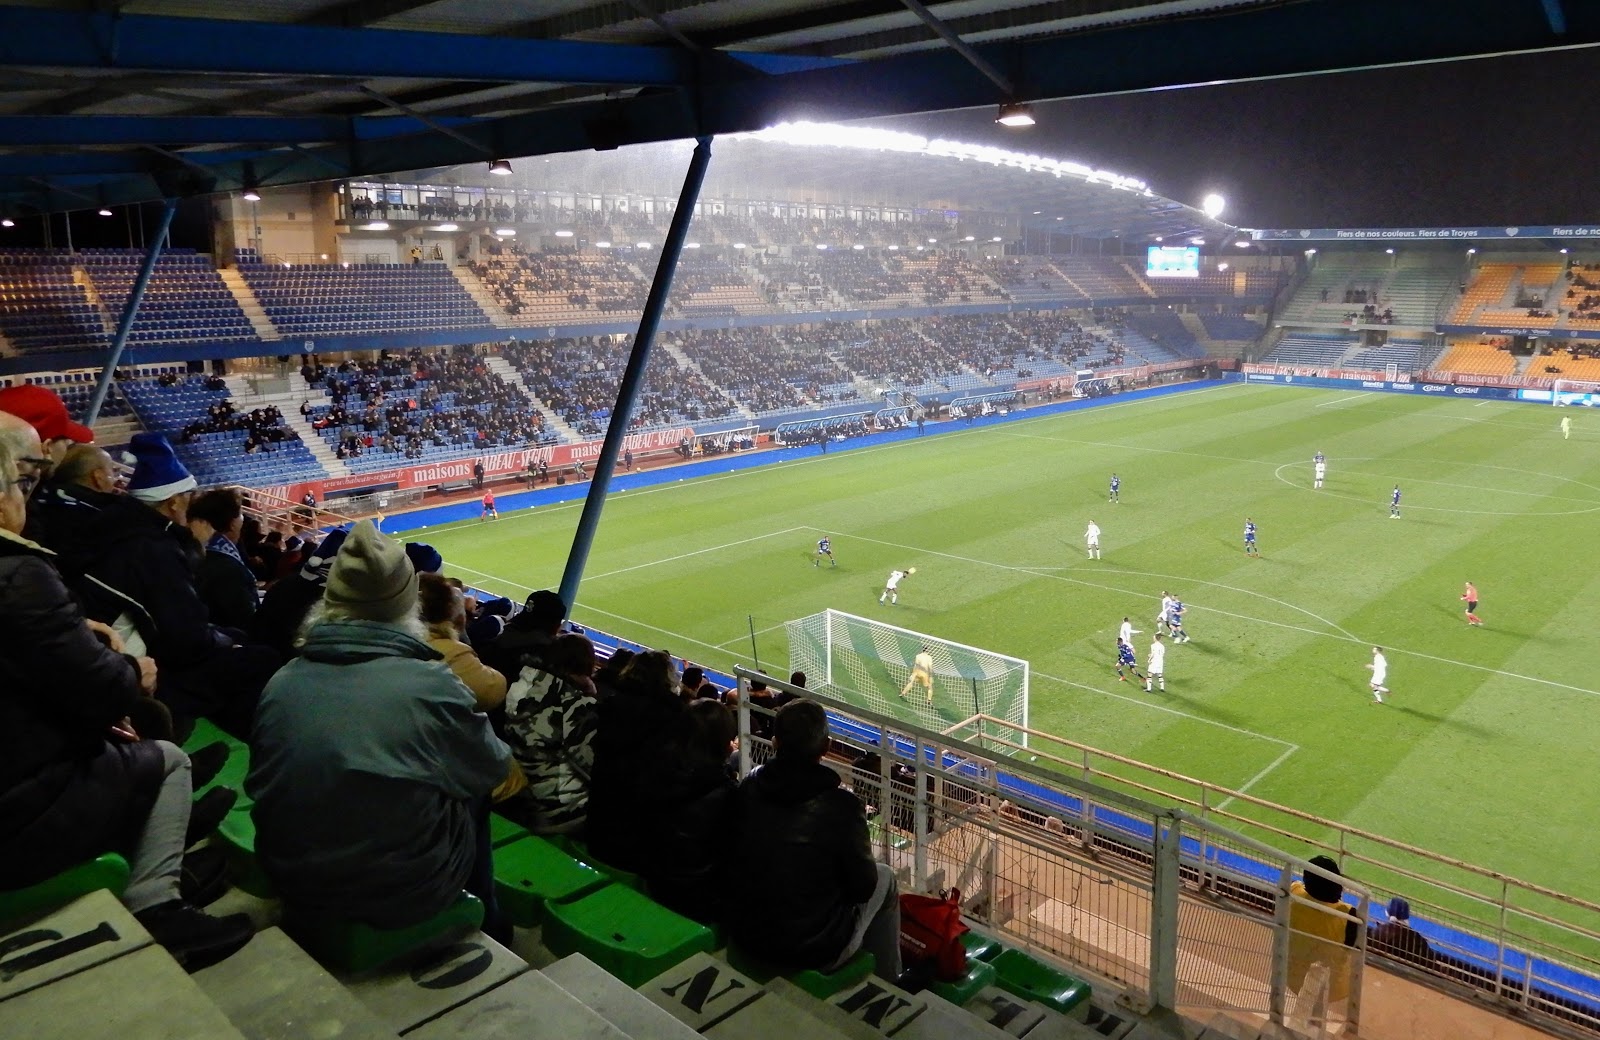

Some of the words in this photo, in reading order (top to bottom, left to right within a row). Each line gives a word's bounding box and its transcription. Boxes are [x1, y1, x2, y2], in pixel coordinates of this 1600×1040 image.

[1337, 230, 1354, 238] Fiers
[1355, 230, 1366, 238] de
[1419, 229, 1437, 237] Fiers
[1438, 229, 1450, 237] de
[1451, 229, 1478, 238] Troyes
[1553, 227, 1573, 236] Fiers
[1575, 227, 1588, 236] de
[1459, 373, 1499, 384] maisons
[413, 462, 471, 483] maisons
[660, 965, 745, 1014] N
